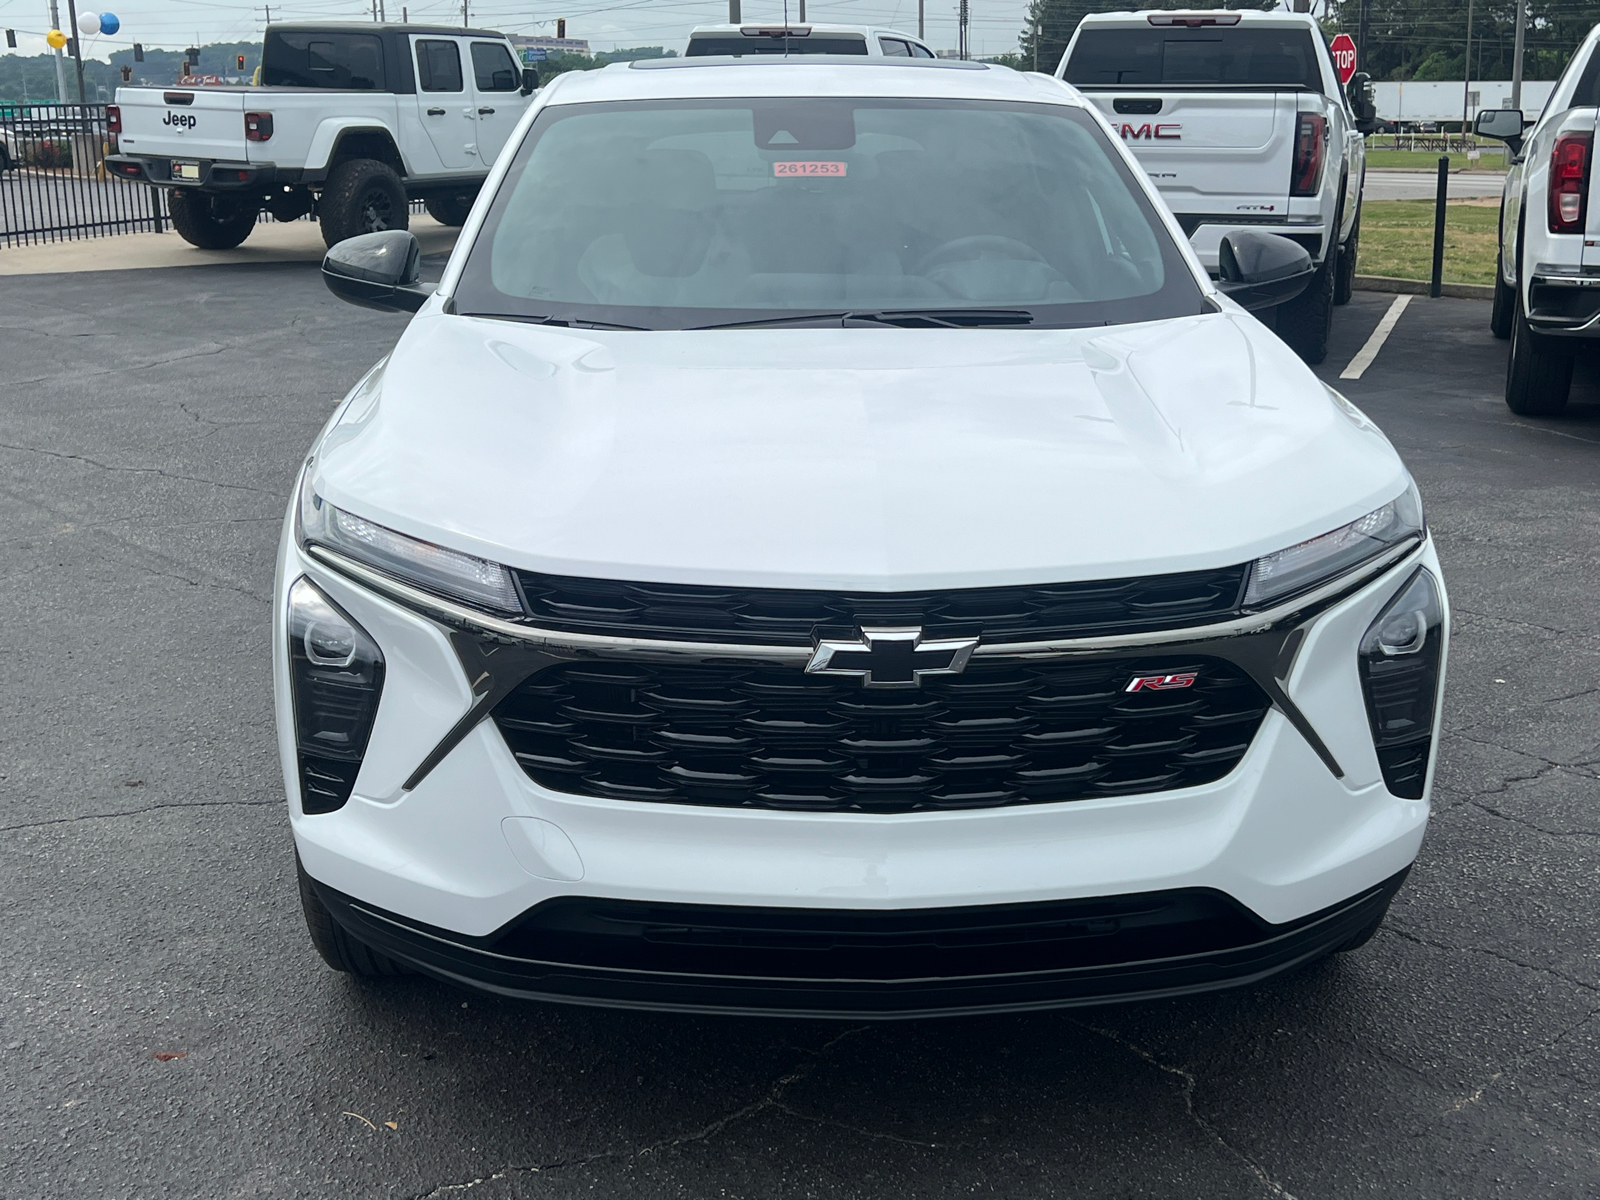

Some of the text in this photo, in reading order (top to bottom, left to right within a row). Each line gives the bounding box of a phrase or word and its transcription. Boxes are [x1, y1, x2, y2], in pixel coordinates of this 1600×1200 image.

[1332, 50, 1354, 69] TOP
[162, 110, 197, 130] Jeep
[777, 163, 840, 173] 261253
[1125, 672, 1198, 692] RS
